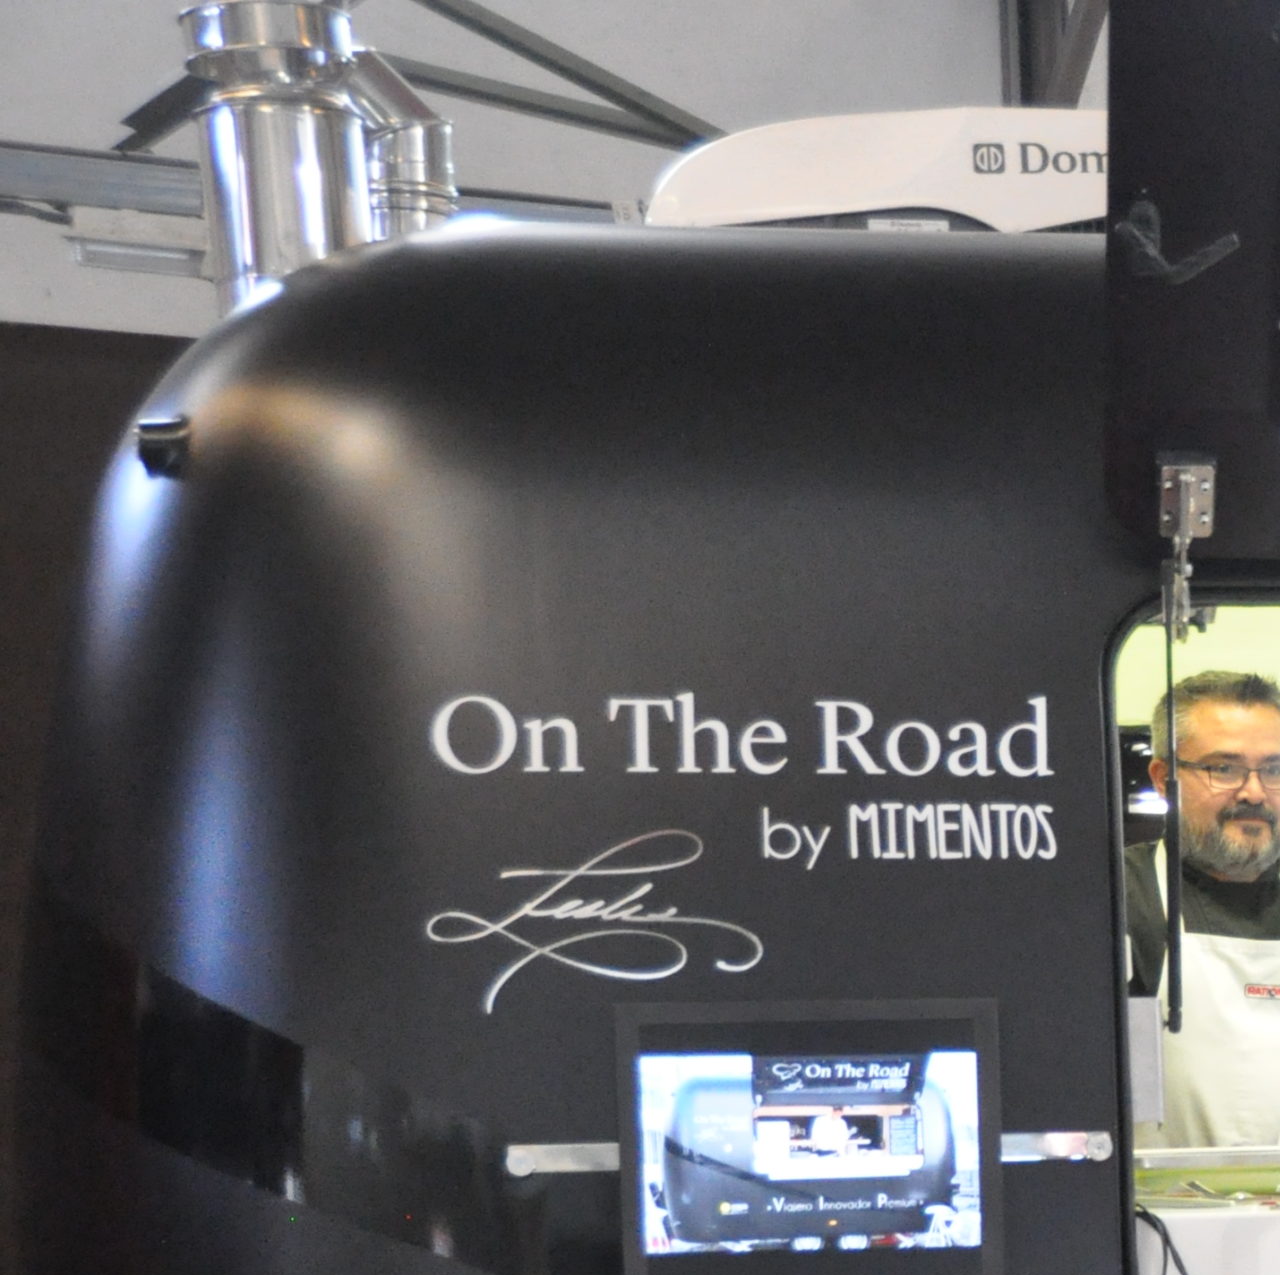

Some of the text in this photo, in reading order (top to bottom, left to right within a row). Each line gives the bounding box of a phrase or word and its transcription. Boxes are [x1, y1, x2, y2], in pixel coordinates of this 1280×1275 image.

[432, 693, 1054, 776] On The Road
[763, 803, 1056, 869] by MIMENTOS
[805, 1062, 911, 1078] On The Road
